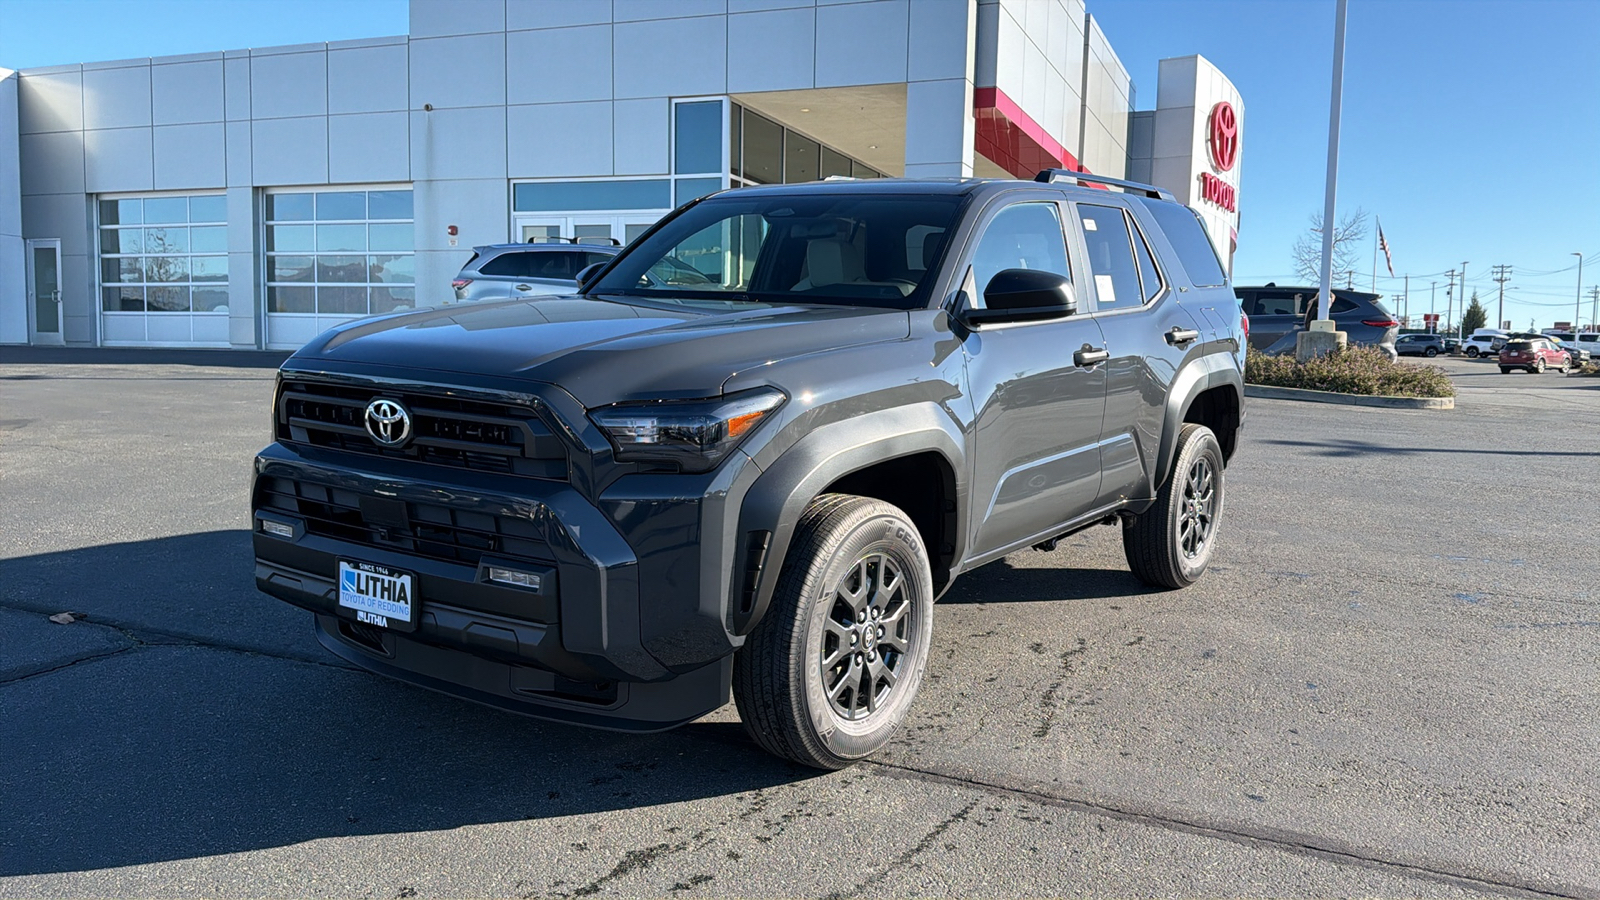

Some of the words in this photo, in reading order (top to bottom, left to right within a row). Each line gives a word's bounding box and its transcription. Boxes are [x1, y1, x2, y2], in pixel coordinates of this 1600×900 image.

[1201, 172, 1235, 213] TOYOTA
[359, 563, 375, 572] SINCE
[376, 566, 389, 575] 1946
[356, 572, 409, 605] LITHIA
[341, 591, 366, 606] TOYOTA
[366, 597, 377, 608] OF
[377, 600, 409, 616] REDDING
[364, 611, 388, 628] LITHIA
